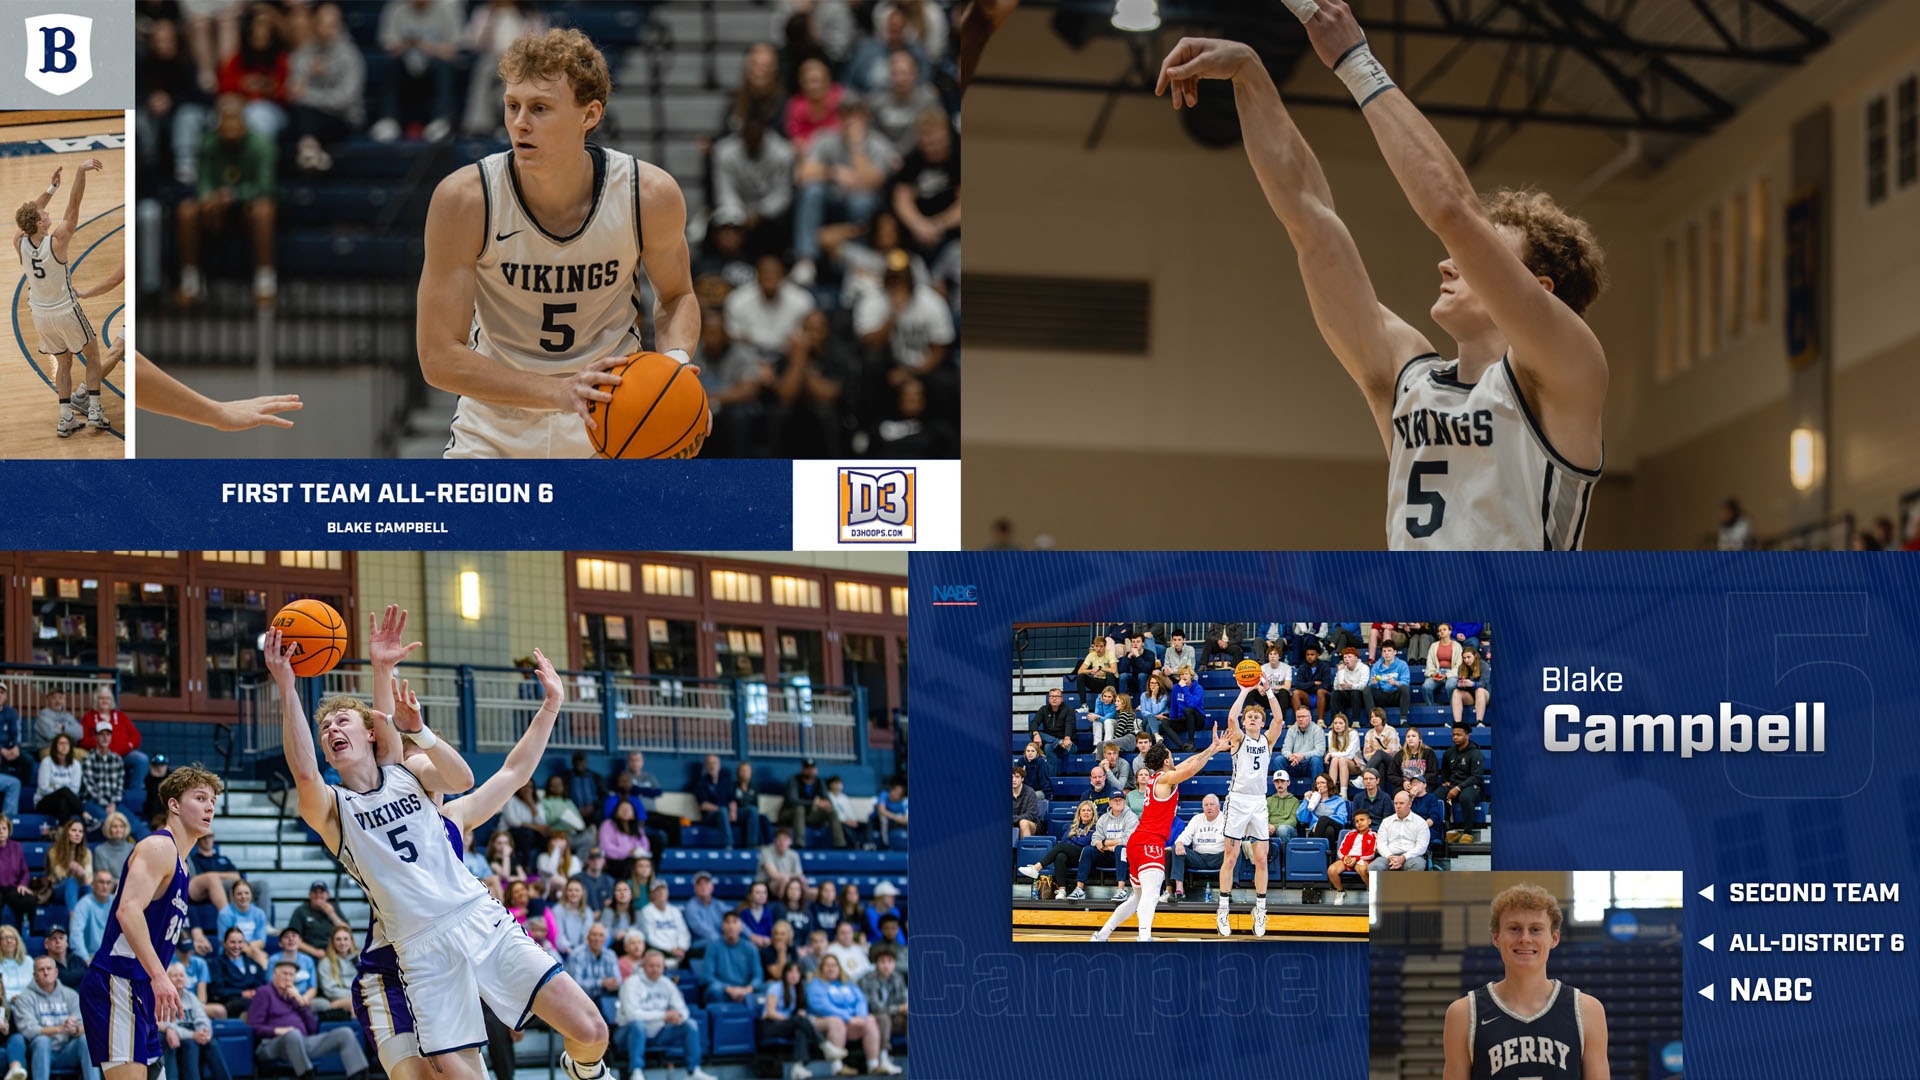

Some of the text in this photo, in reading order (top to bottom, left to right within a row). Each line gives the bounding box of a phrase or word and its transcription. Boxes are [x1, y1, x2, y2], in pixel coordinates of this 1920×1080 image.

[32, 258, 46, 279] 5
[500, 259, 619, 293] VIKINGS
[539, 302, 577, 353] 5
[1405, 460, 1449, 539] 5
[1253, 756, 1261, 771] 5
[354, 793, 422, 830] VIKINGS
[386, 824, 419, 863] 5
[1488, 1036, 1570, 1076] BERRY
